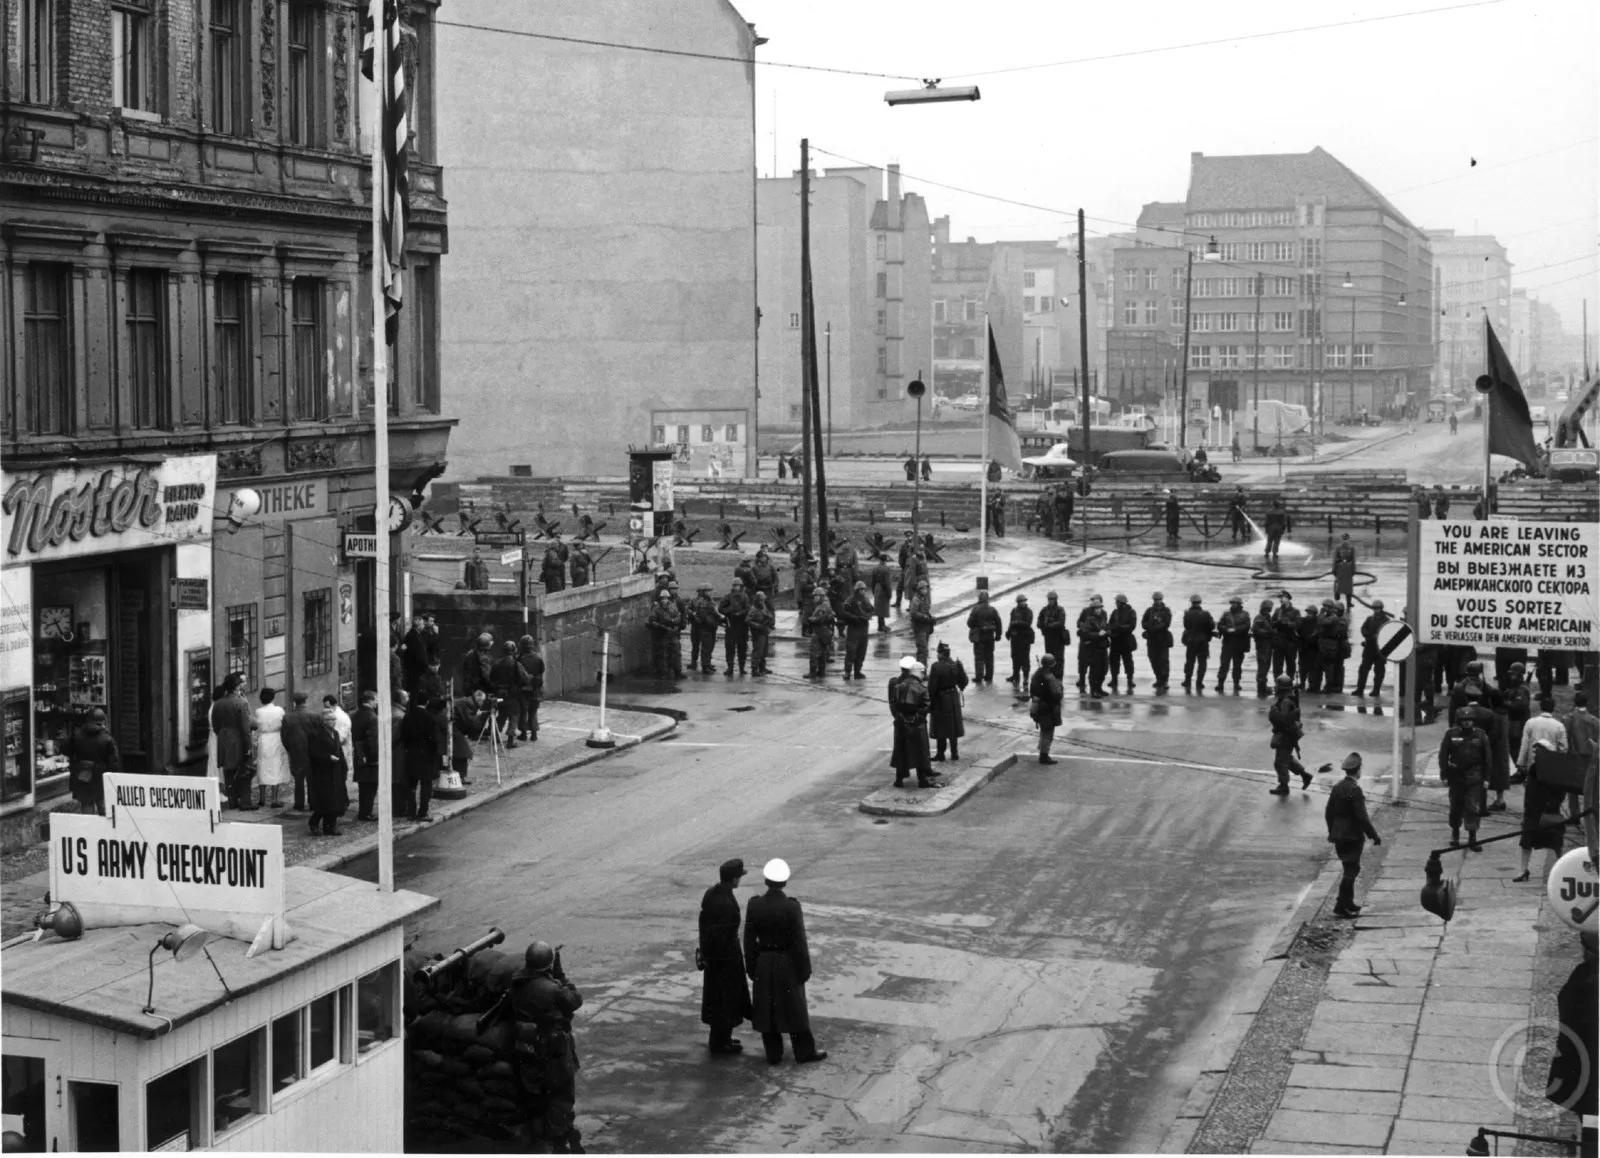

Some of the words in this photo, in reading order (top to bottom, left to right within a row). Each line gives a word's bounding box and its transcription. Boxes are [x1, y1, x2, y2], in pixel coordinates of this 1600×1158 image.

[166, 504, 199, 523] RADIO
[1443, 525, 1471, 538] YOU
[1480, 527, 1509, 539] ARE
[1518, 527, 1580, 541] LEAVING
[1435, 542, 1457, 554] THE
[1464, 542, 1530, 556] AMERICAN
[1538, 544, 1588, 557] SECTOR
[1437, 562, 1459, 574] ВЫ
[1468, 562, 1557, 577] ВЫЕЗЖАЕТЕ
[1567, 565, 1585, 577] ИЗ
[1434, 578, 1532, 593] АМЕРИКАНСКОГО
[1538, 580, 1590, 595] СЕКТОРА
[1457, 599, 1496, 612] VOUS
[1505, 600, 1562, 615] SORTEZ
[1431, 615, 1447, 627] DU
[1456, 616, 1511, 629] SECTEUR
[1518, 618, 1591, 632] AMERICAIN
[1430, 631, 1441, 640] SIE
[1445, 631, 1482, 642] VERLASSEN
[1486, 633, 1499, 642] DEN
[1502, 634, 1561, 645] AMERIKANISCHEN
[1564, 636, 1590, 645] SEKTOR
[117, 785, 145, 807] ALLIED
[150, 787, 206, 810] CHECKPOINT
[98, 839, 148, 880] ARMY
[156, 842, 268, 889] CHECKPOINT
